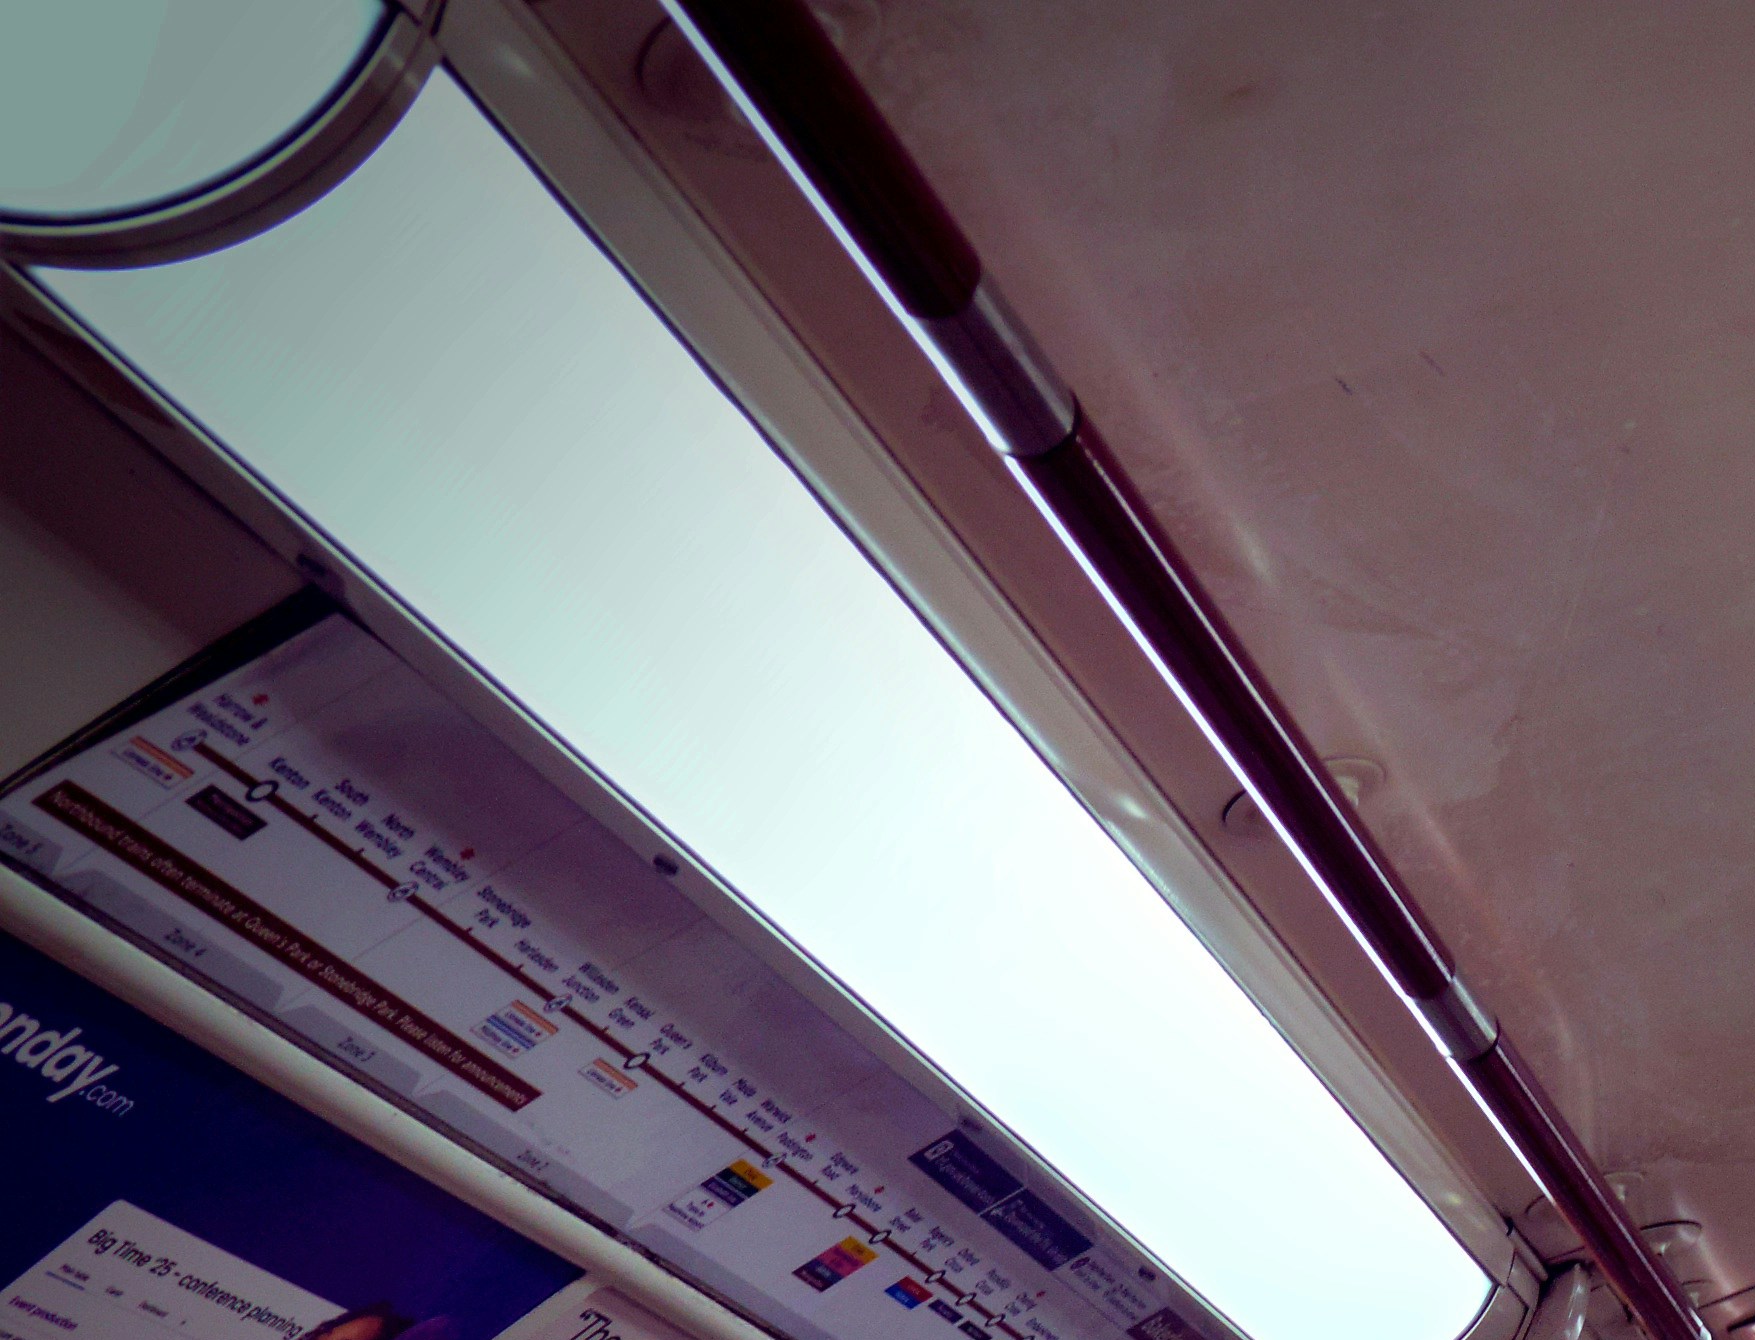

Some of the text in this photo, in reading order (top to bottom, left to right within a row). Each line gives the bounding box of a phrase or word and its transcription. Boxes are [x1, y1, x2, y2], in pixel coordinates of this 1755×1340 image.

[268, 757, 309, 789] Kenton
[311, 788, 351, 818] Kenton
[334, 778, 369, 804] South
[354, 820, 400, 858] Wembley
[382, 813, 414, 837] North
[408, 860, 445, 890] Central
[424, 846, 468, 881] Wembley
[476, 885, 531, 928] Stonebridge
[477, 908, 499, 928] Park
[517, 939, 558, 970] Harlesden
[87, 1228, 116, 1254] Big
[113, 1240, 151, 1267] Time
[178, 1274, 251, 1313] conference
[241, 1306, 302, 1340] planning
